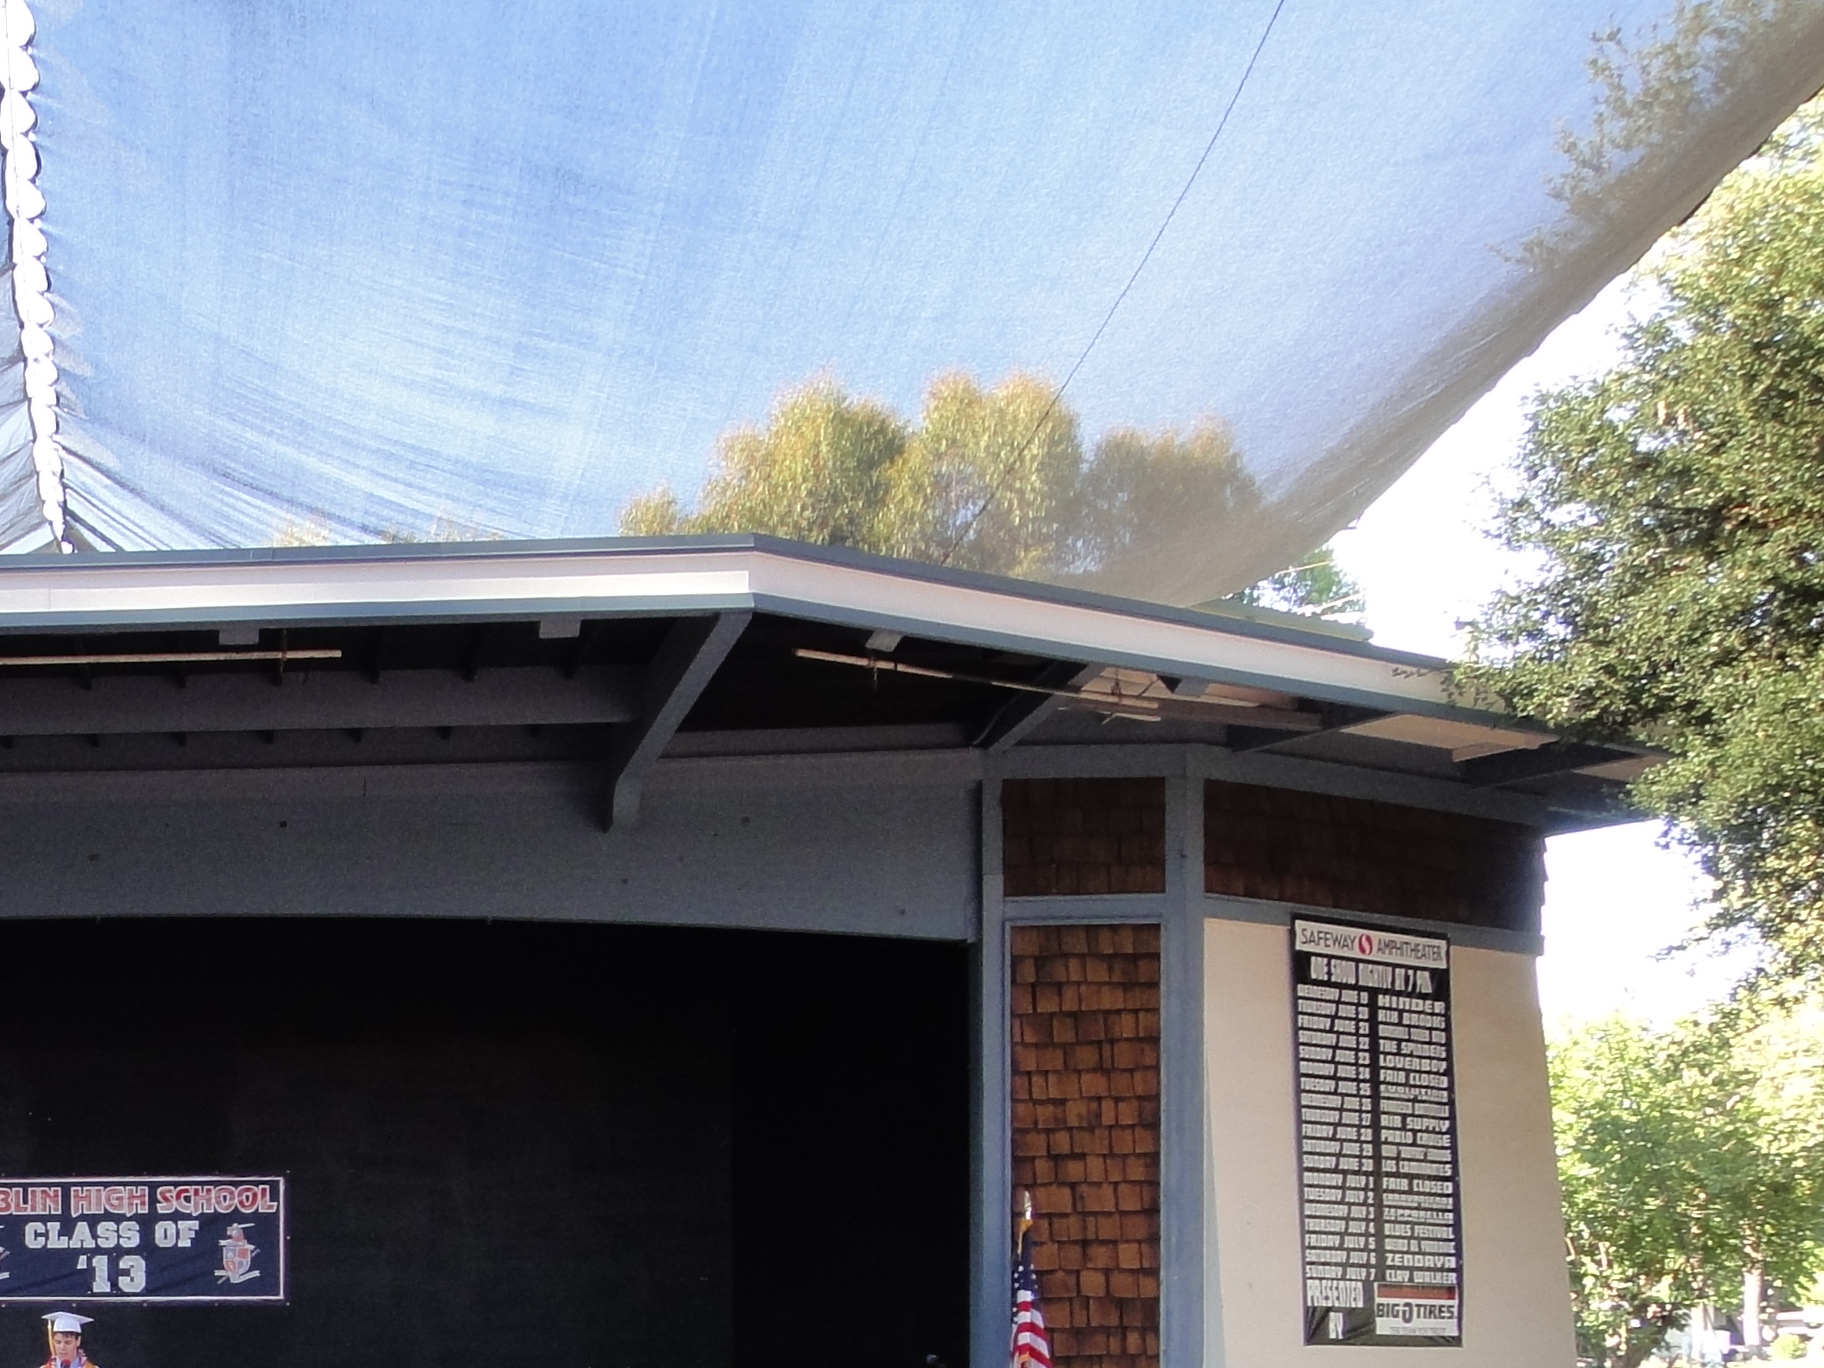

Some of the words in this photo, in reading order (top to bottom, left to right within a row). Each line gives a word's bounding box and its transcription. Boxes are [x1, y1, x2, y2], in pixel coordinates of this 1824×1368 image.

[1301, 927, 1356, 951] SAFEWAY
[1376, 937, 1442, 962] AMPHITHEATER
[1407, 969, 1414, 992] 7
[1377, 993, 1445, 1014] HINDER
[1378, 1054, 1447, 1073] LOVERBOY
[1379, 1069, 1405, 1083] FAIR
[1408, 1072, 1448, 1087] CLOSED
[1380, 1115, 1401, 1127] AIR
[1405, 1117, 1450, 1132] SUPPLY
[1368, 1176, 1374, 1188] 1
[1382, 1177, 1408, 1190] FAIR
[1412, 1179, 1453, 1193] CLOSED
[71, 1185, 149, 1217] HIGH
[156, 1184, 278, 1216] SCHOOL
[1367, 1191, 1374, 1203] 2
[1367, 1206, 1374, 1218] 3
[24, 1221, 140, 1249] CLASS
[154, 1221, 200, 1248] OF
[1368, 1222, 1375, 1233] 4
[1368, 1237, 1376, 1249] 5
[1369, 1252, 1376, 1264] 6
[1384, 1253, 1456, 1268] ZENDAYA
[1369, 1268, 1376, 1280] 7
[1306, 1280, 1363, 1307] PRESENTED
[1376, 1303, 1399, 1318] BIG
[1414, 1304, 1455, 1319] TIRES
